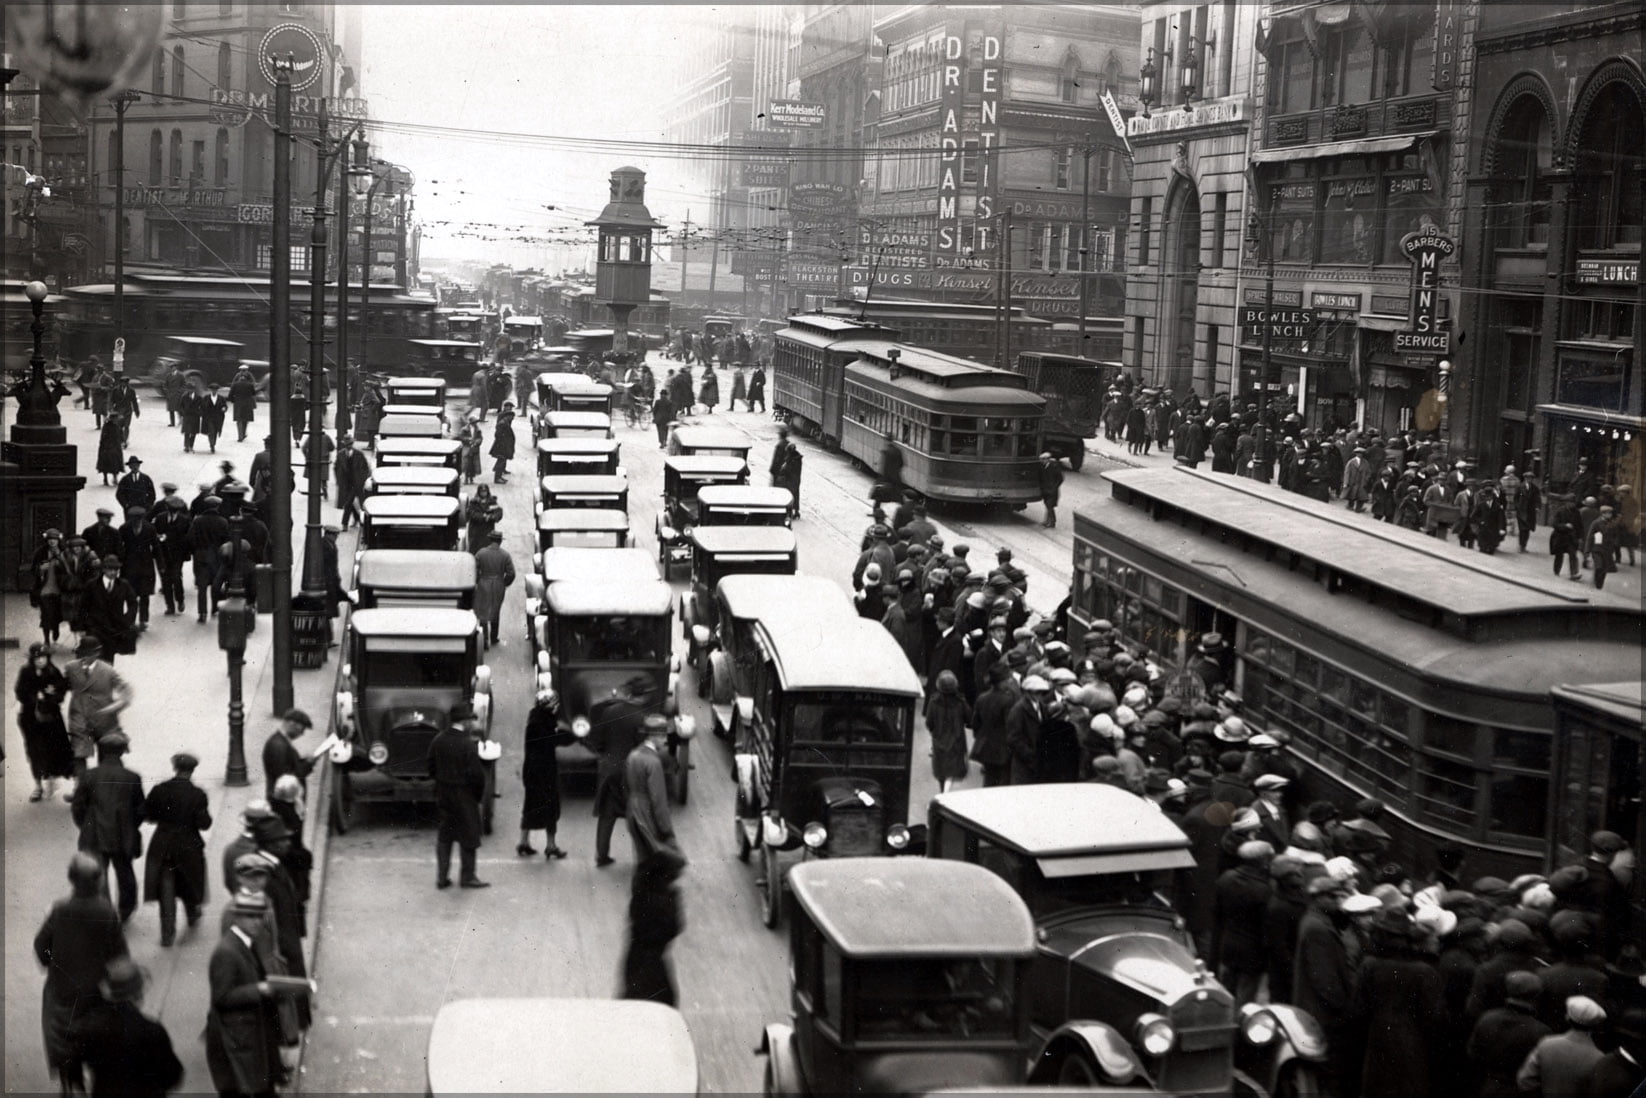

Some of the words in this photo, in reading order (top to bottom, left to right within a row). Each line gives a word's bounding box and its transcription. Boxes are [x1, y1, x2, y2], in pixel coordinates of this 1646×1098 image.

[1105, 98, 1124, 132] DENTIST
[978, 36, 999, 250] DENTIST
[753, 164, 787, 174] PANTS
[939, 109, 958, 249] ADAMS
[1390, 178, 1421, 192] 2-PANT
[1035, 204, 1096, 220] ADAMS
[1425, 226, 1437, 236] 15
[882, 233, 929, 247] ADAMS
[1406, 237, 1453, 254] BARBERS
[861, 254, 927, 268] DENTISTS
[952, 257, 990, 271] ADAMS
[1603, 265, 1638, 281] LUNCH
[1031, 302, 1080, 313] DRUGS
[1314, 294, 1336, 306] BOWLES
[1337, 295, 1356, 307] LUNCH
[1247, 310, 1310, 323] BOWLES
[1253, 325, 1304, 337] LNCH
[1396, 334, 1448, 348] SERVICE
